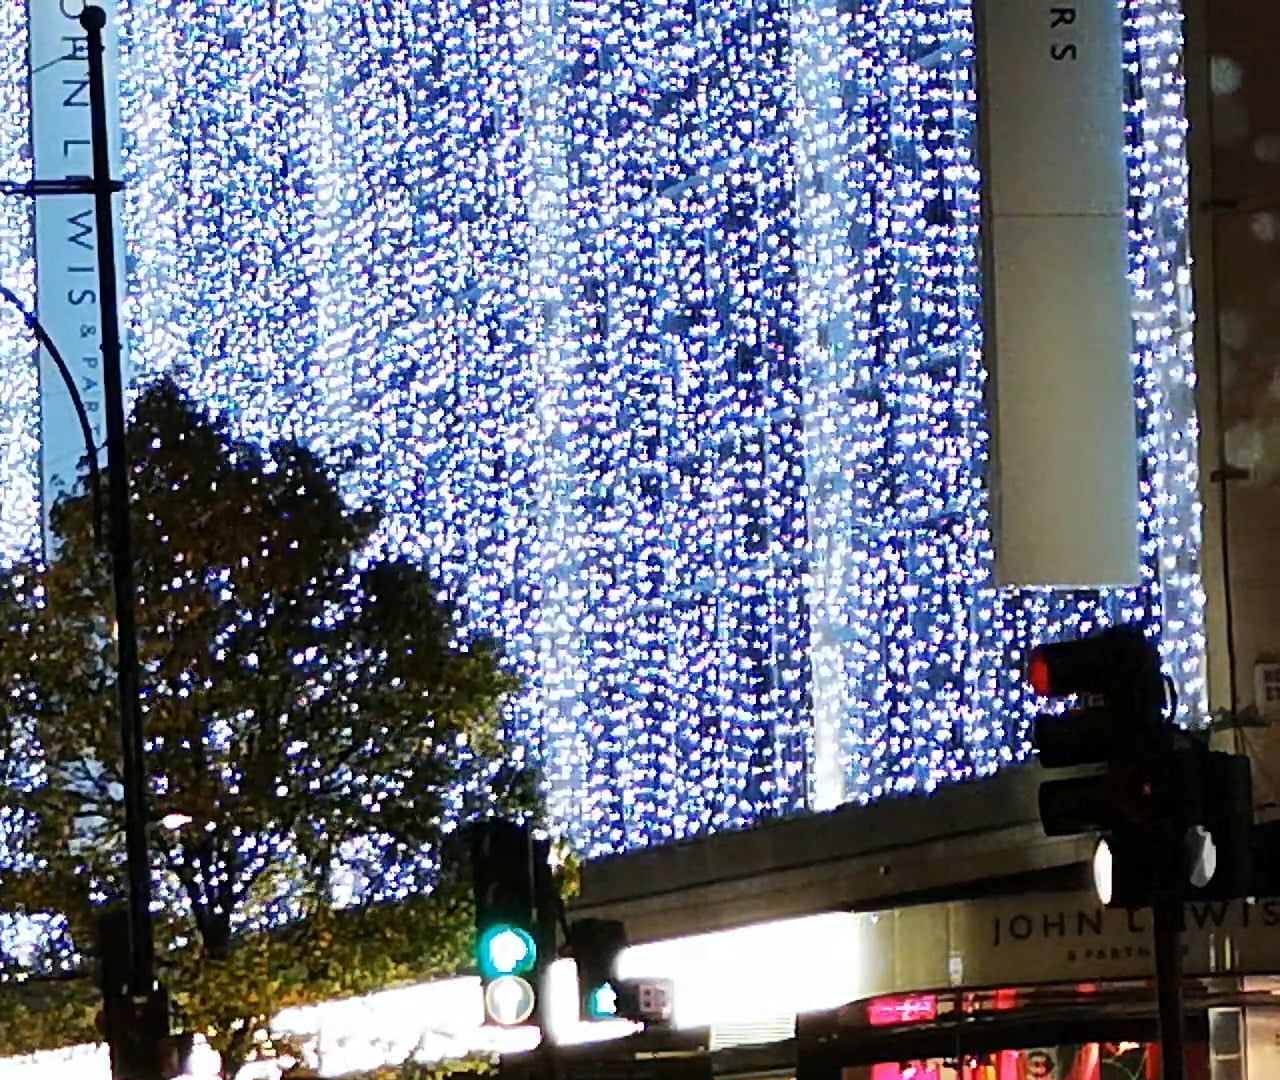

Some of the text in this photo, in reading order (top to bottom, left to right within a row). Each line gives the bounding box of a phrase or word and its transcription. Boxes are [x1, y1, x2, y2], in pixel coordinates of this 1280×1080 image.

[63, 139, 97, 307] LWIS
[79, 323, 97, 339] &
[993, 900, 1280, 947] JOHN LWIS
